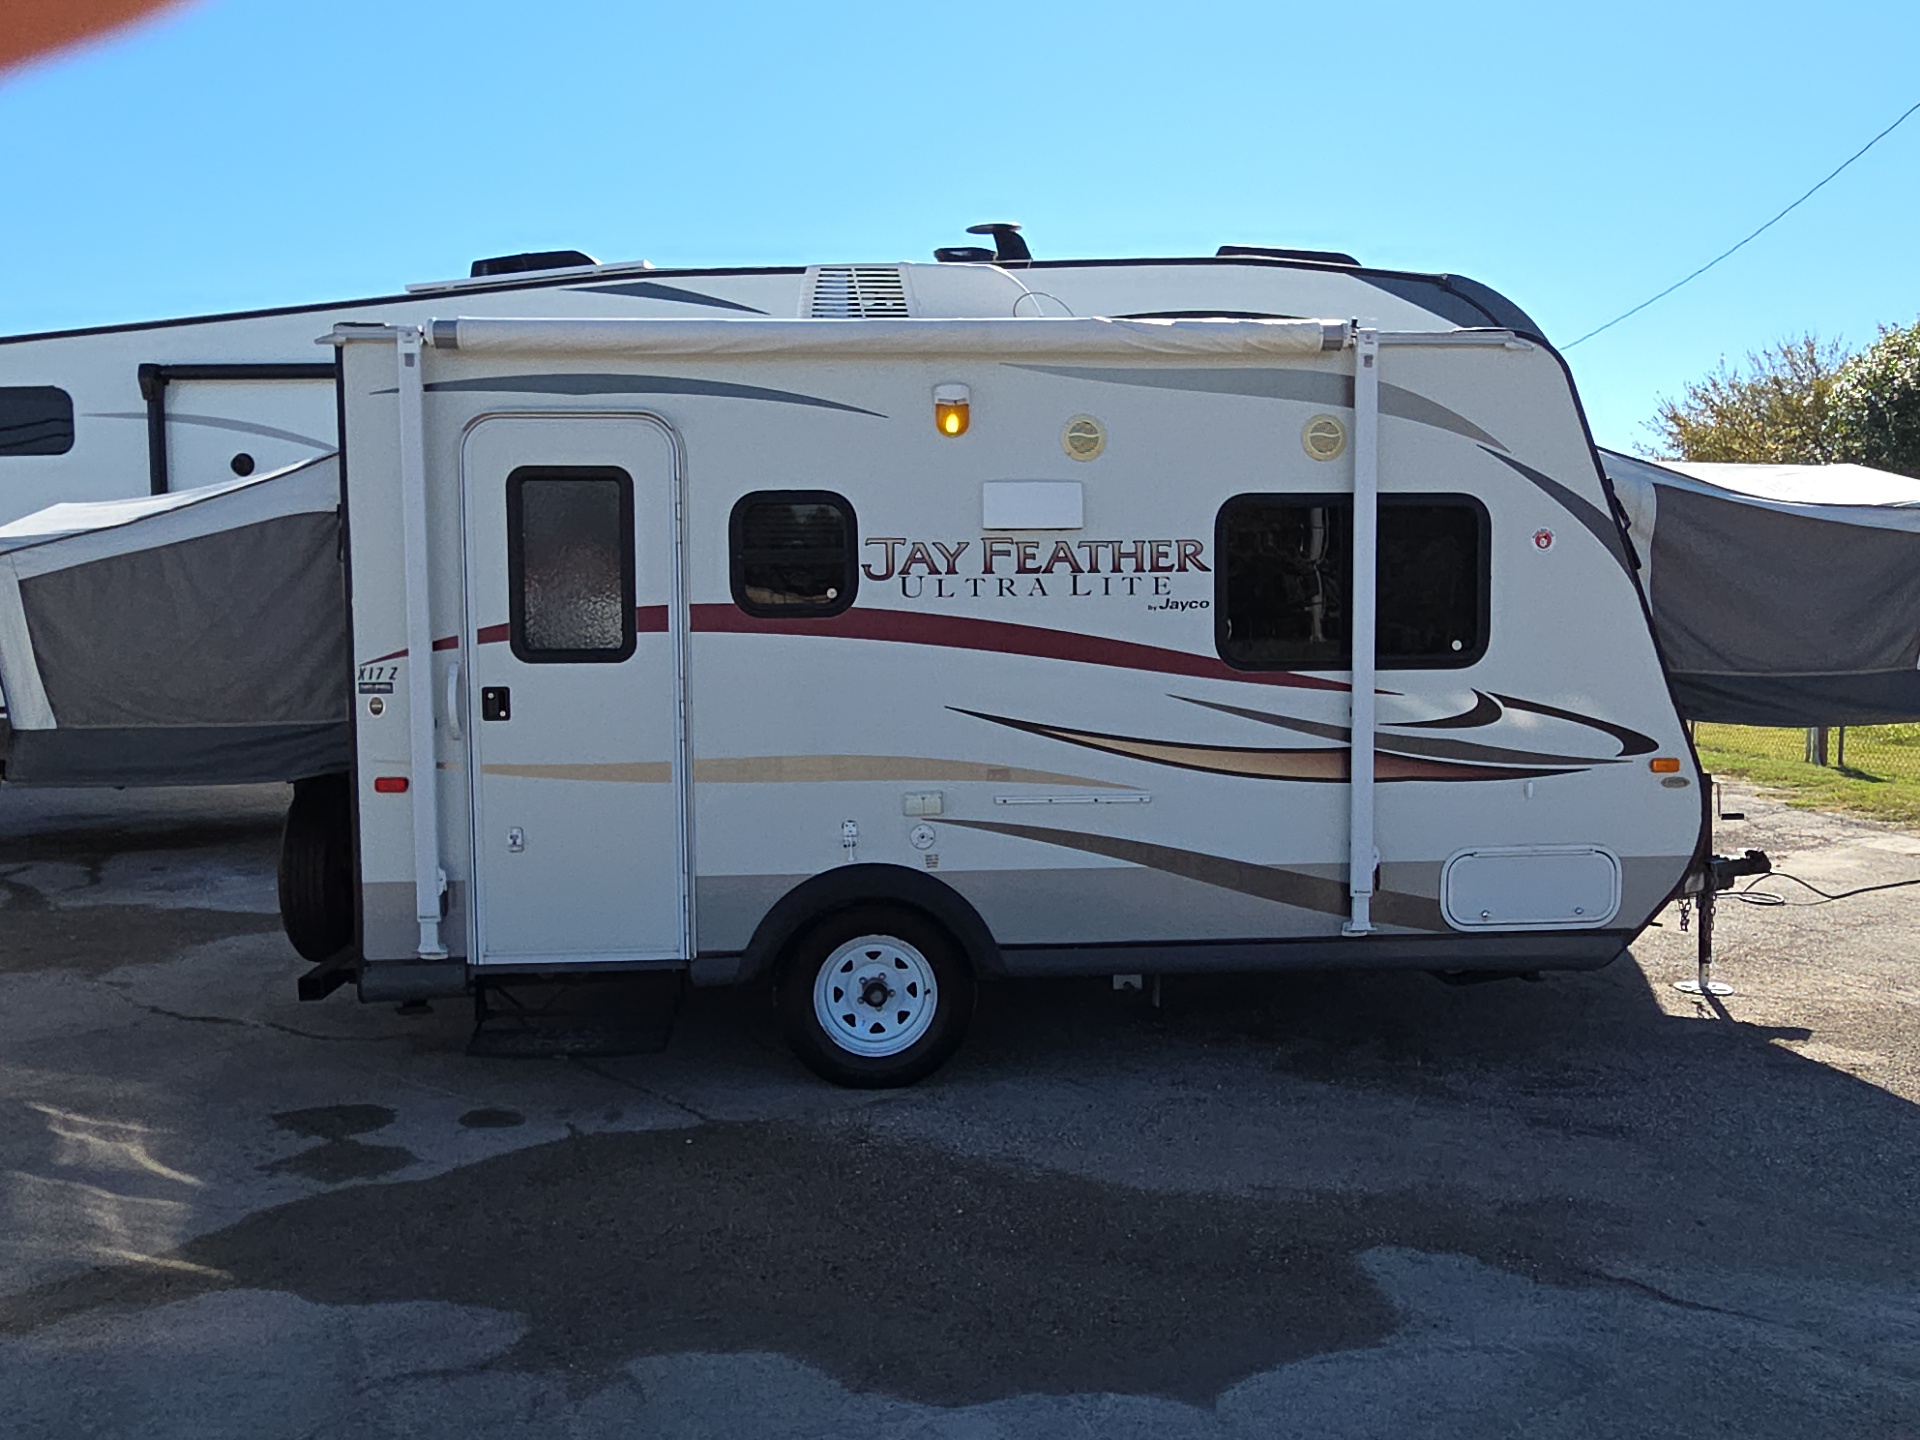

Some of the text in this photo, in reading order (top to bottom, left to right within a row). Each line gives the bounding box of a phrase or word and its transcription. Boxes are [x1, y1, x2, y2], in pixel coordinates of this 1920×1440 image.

[861, 537, 1212, 580] JAY FEATHER
[900, 574, 1171, 598] ULTRA LITE
[1158, 597, 1210, 612] Jayco
